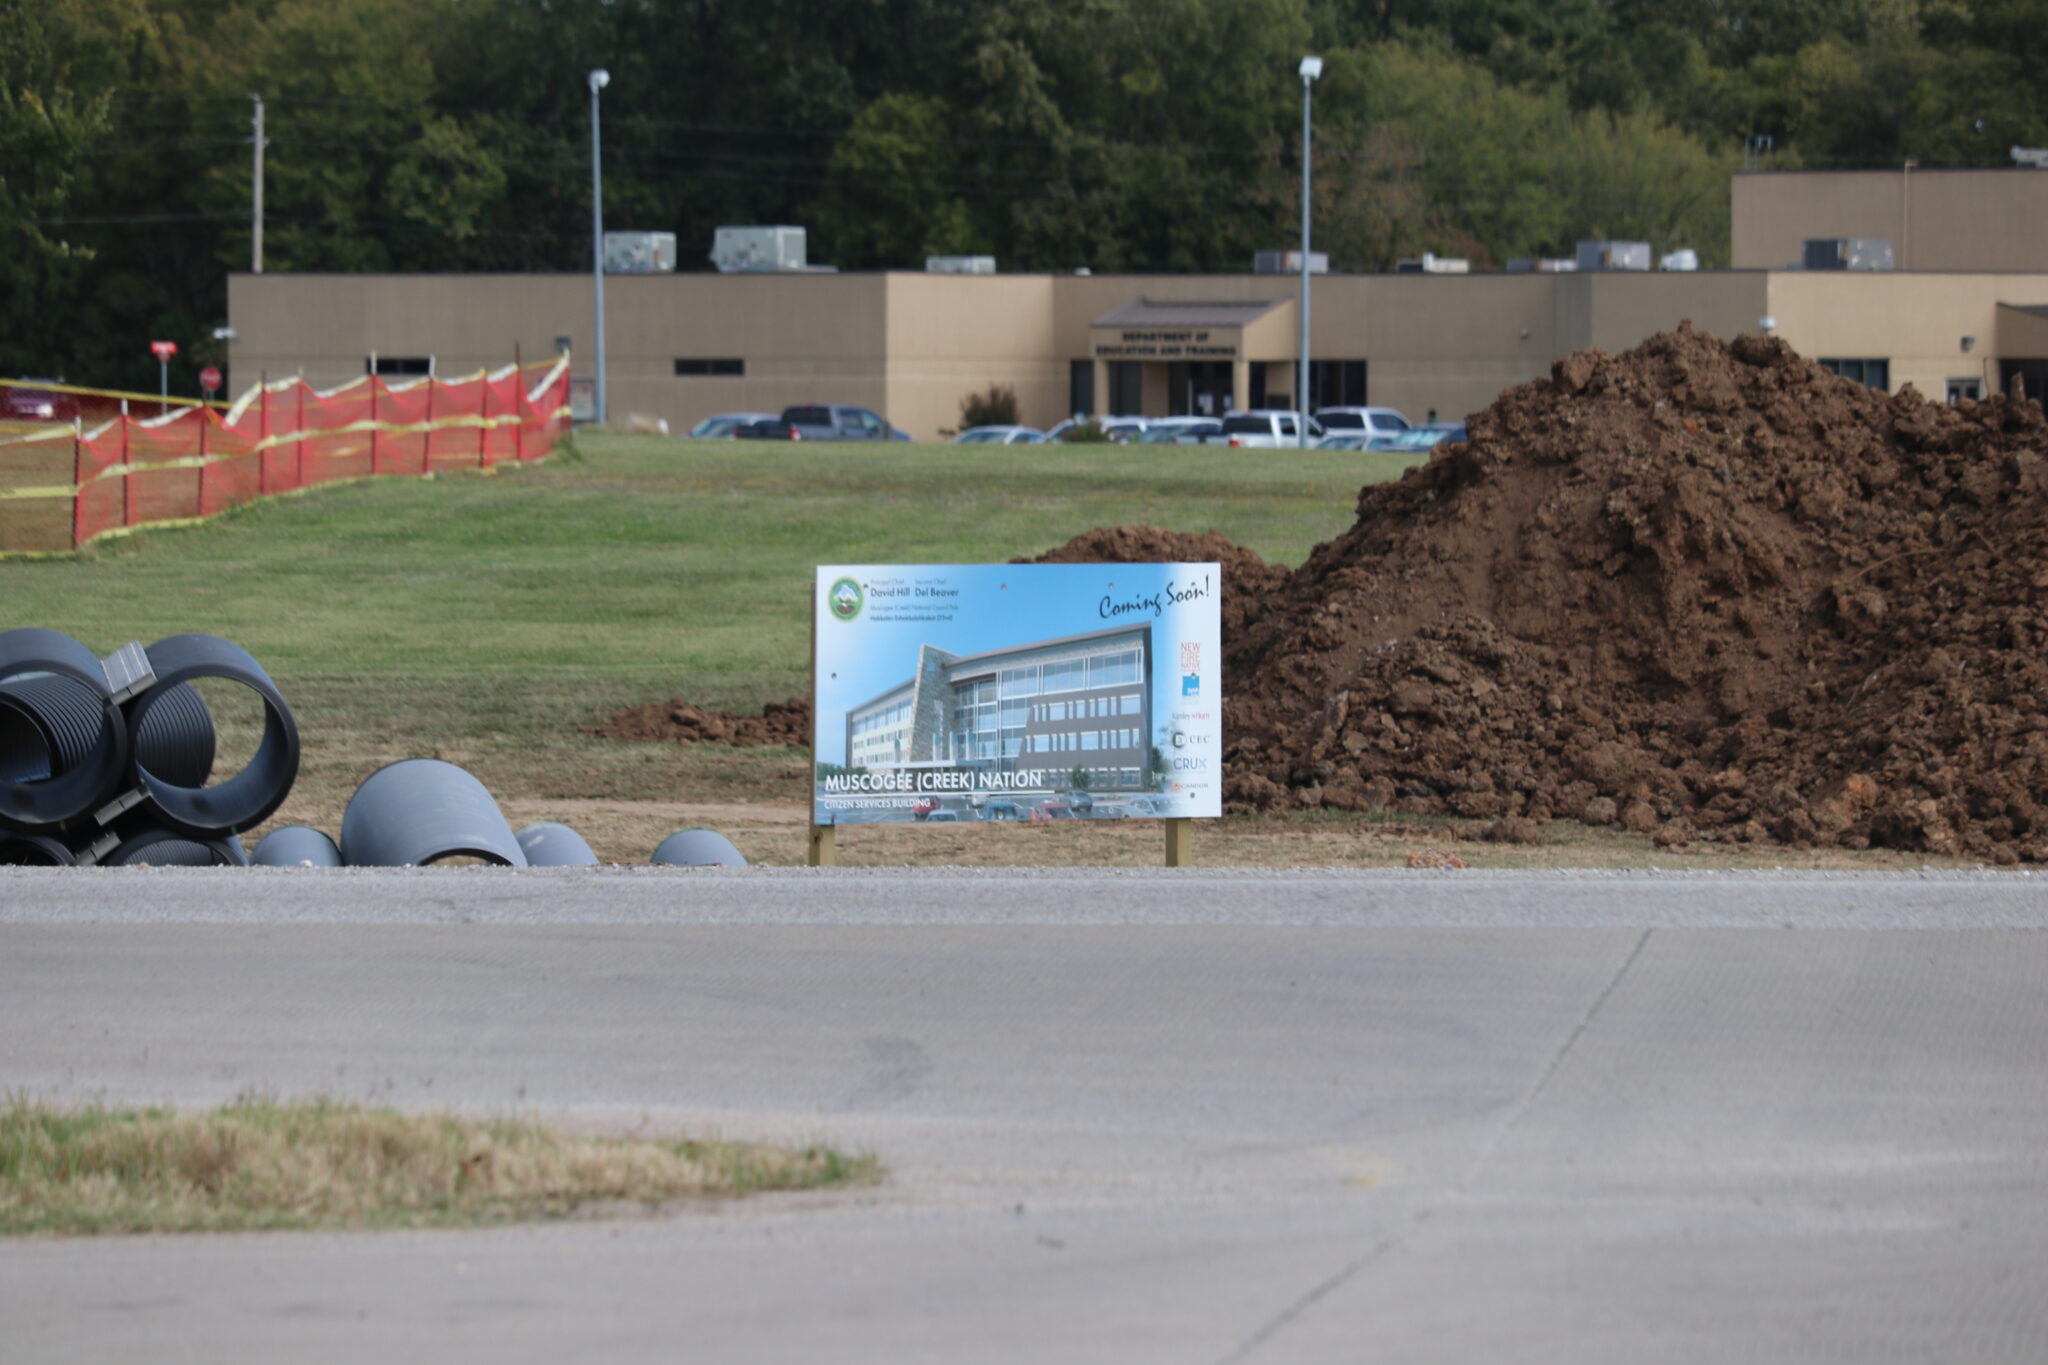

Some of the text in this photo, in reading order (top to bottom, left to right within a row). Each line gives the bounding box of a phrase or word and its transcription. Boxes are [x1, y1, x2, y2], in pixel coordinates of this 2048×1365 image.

[870, 587, 911, 598] David Hill
[915, 587, 960, 597] Del Beaver
[1099, 574, 1209, 618] Coming Soon!
[1181, 642, 1200, 651] NEW
[1173, 757, 1207, 770] CRUX
[824, 771, 1042, 792] MUSCOGEE (CREEK) NATION
[825, 798, 931, 809] CITIZEN SERVICES BUILDING
